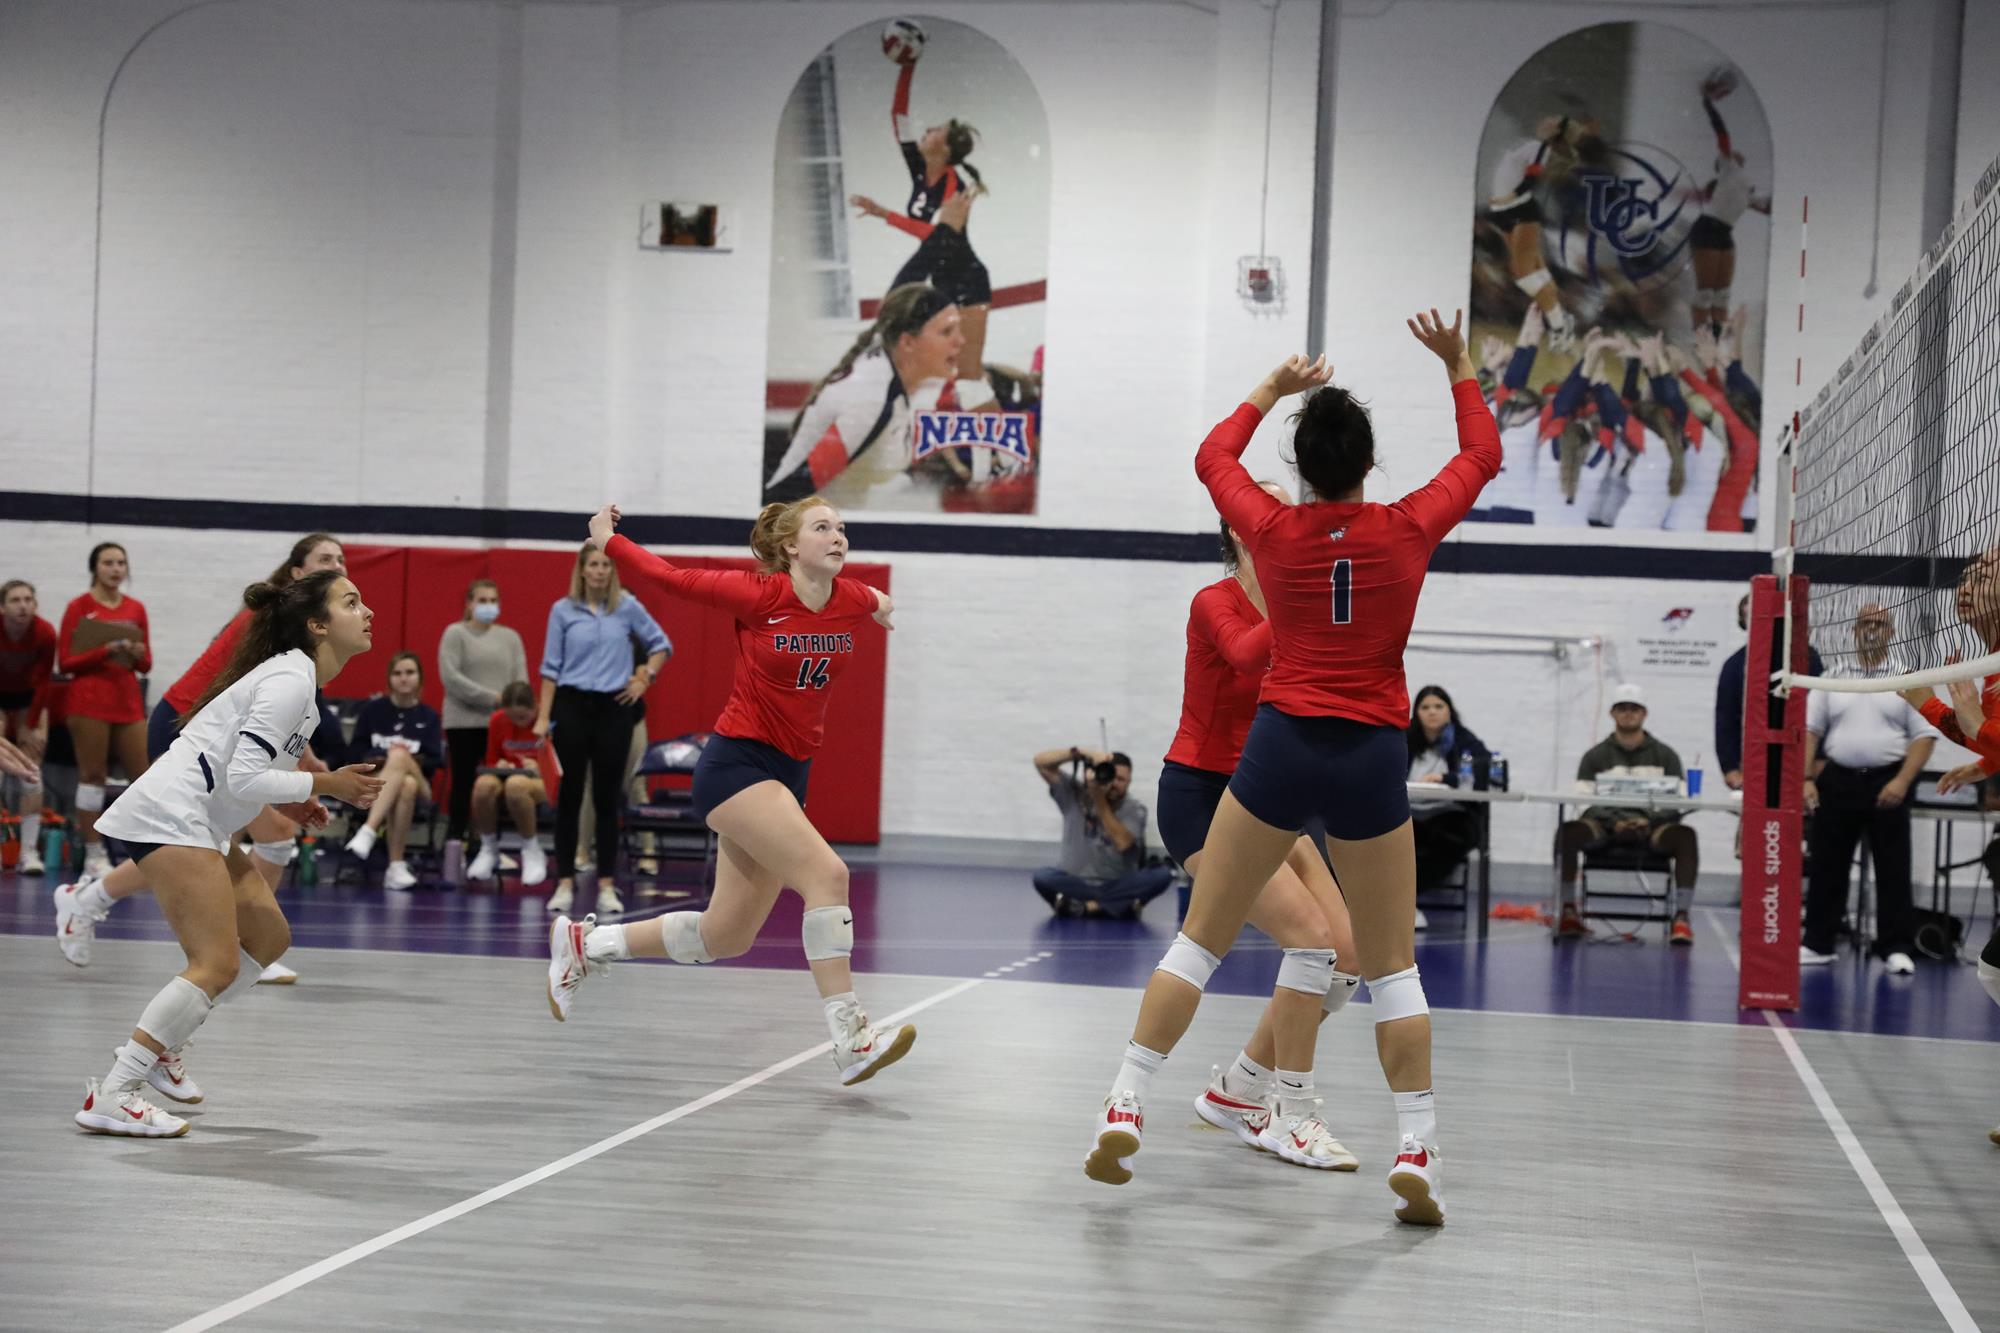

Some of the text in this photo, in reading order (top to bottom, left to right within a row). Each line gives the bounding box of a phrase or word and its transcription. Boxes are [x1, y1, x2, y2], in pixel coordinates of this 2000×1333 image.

[1583, 175, 1659, 257] UC
[916, 412, 1030, 462] NAIA
[1330, 559, 1352, 624] 1
[774, 632, 853, 653] PATRIOTS
[796, 658, 830, 689] 14
[1763, 821, 1781, 875] sports
